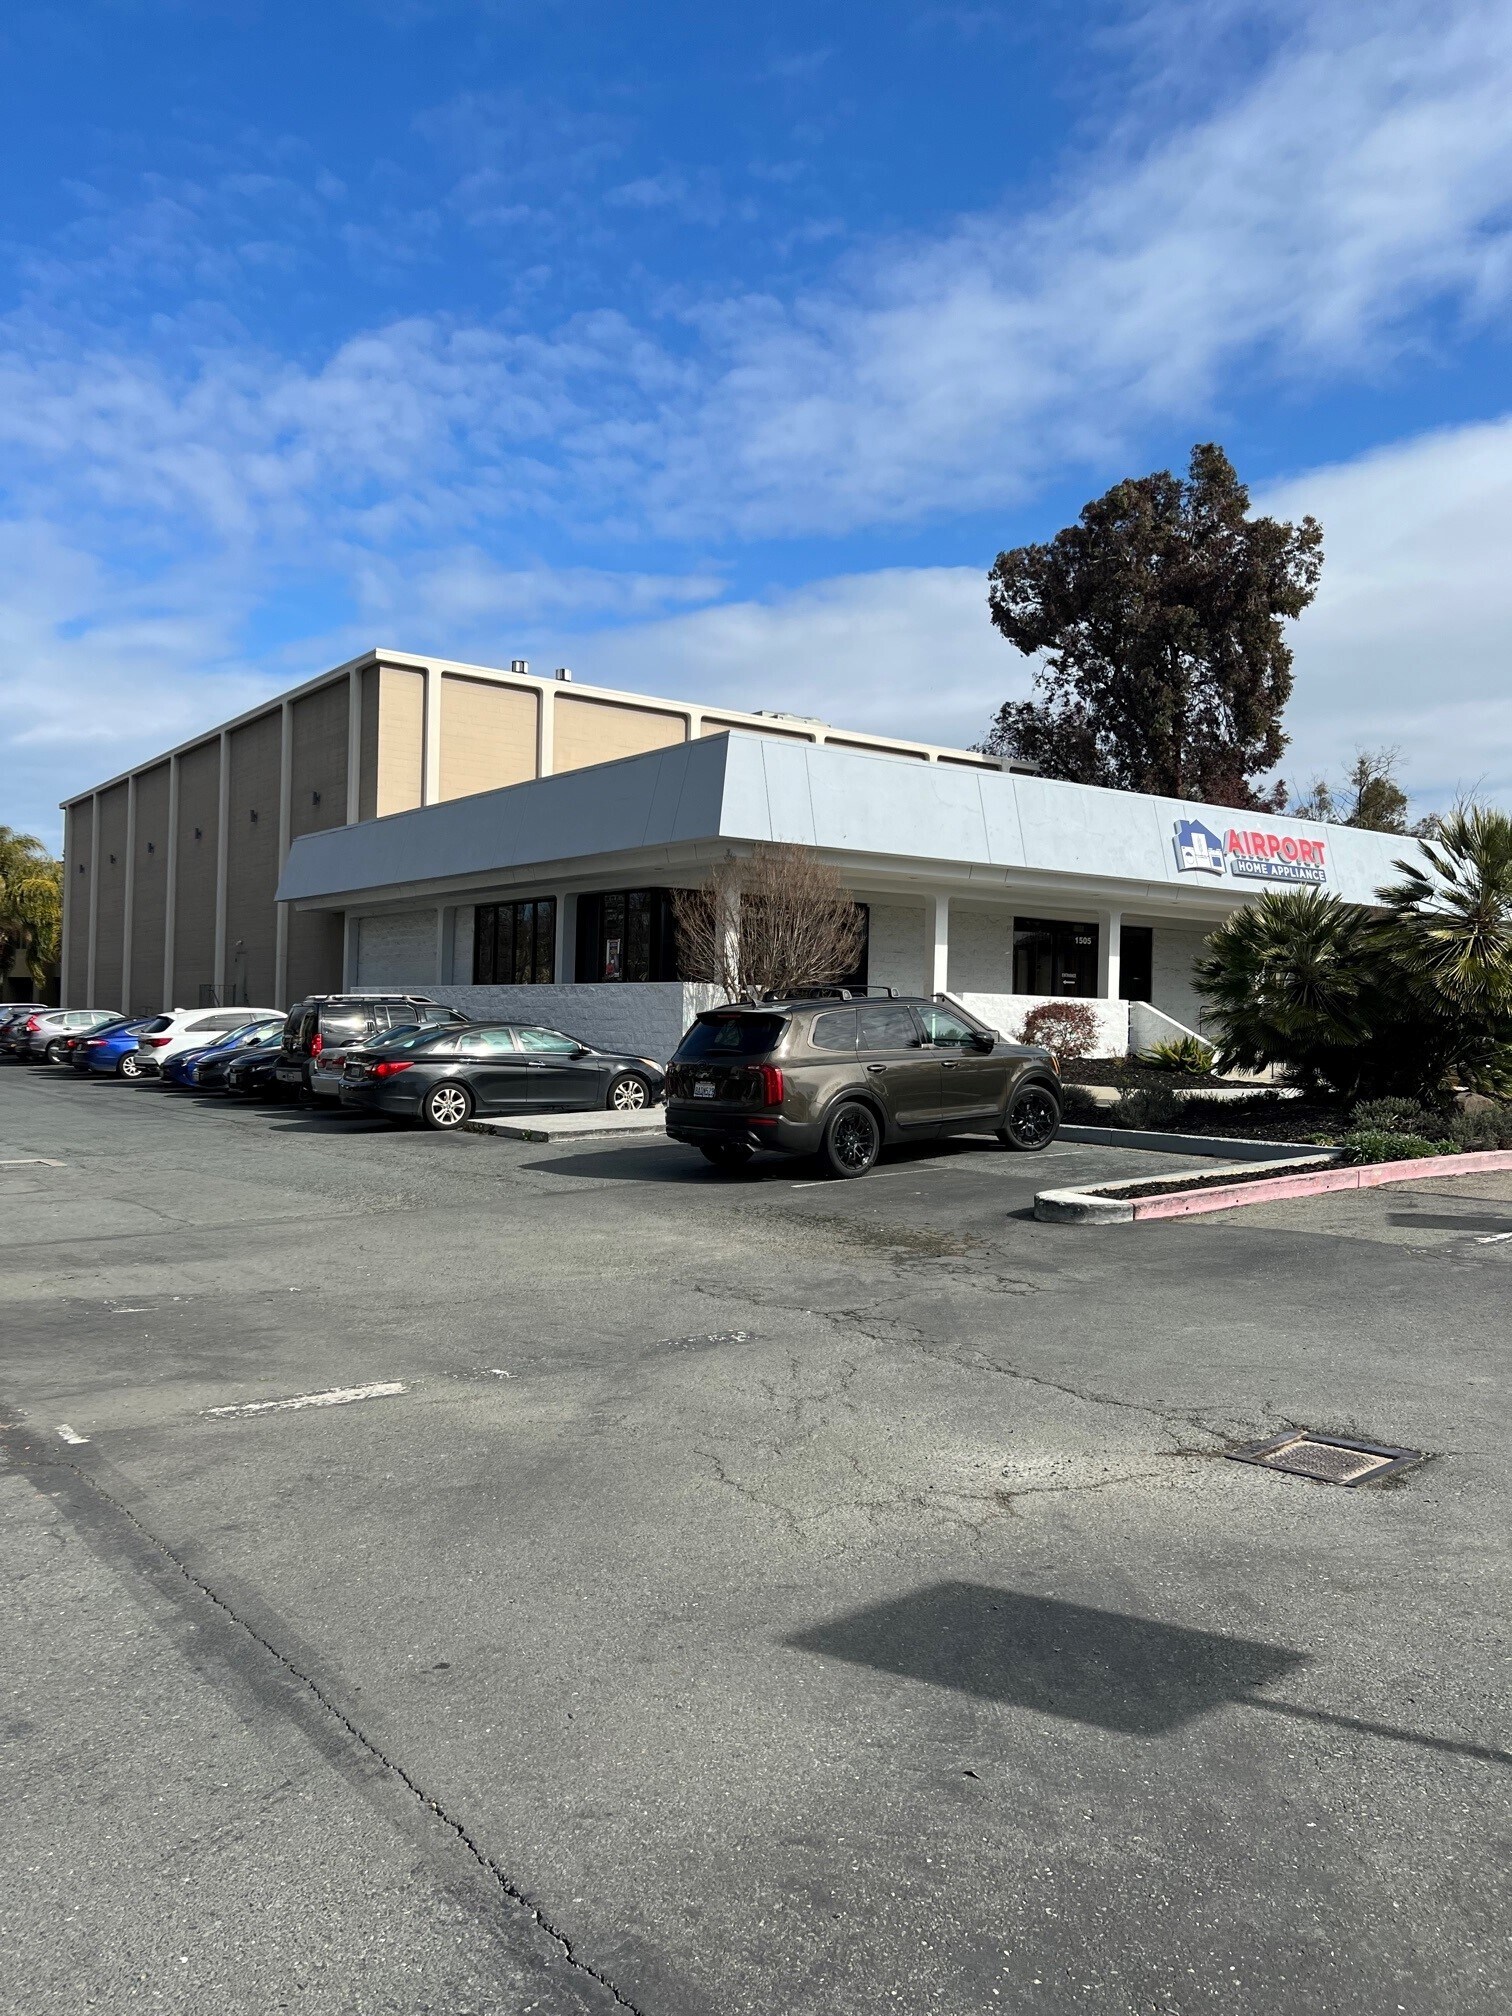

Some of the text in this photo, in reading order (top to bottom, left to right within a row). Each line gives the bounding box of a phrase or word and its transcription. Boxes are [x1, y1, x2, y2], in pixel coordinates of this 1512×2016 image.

[1227, 828, 1325, 865] AIRPORT
[1238, 860, 1325, 881] HOME APPLIANCE
[1075, 936, 1092, 945] 1505
